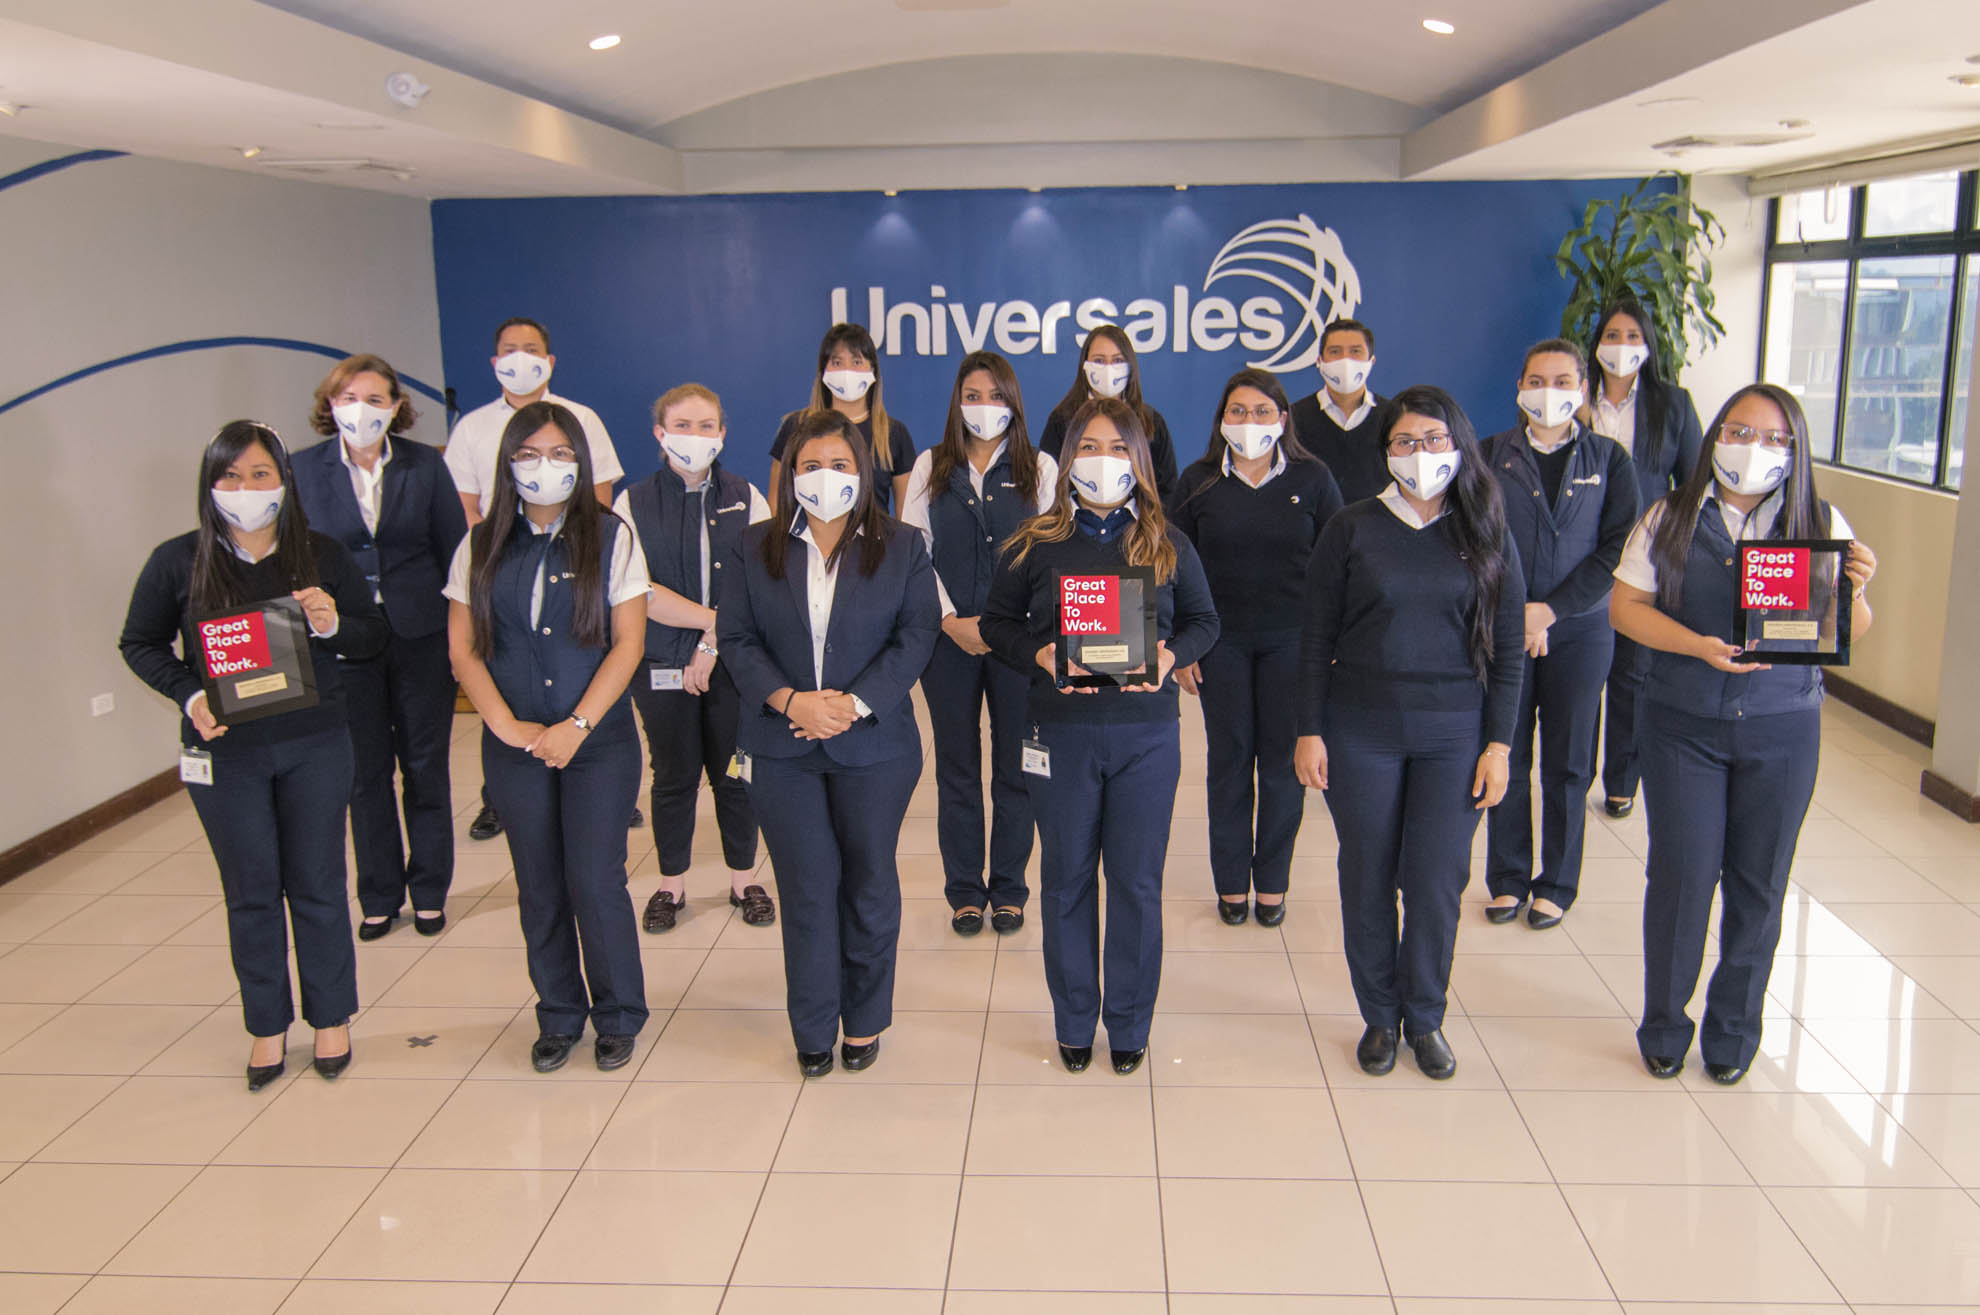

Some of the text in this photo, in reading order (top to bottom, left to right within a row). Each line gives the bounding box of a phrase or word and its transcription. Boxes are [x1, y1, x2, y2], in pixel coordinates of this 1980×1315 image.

[831, 284, 1285, 355] Universales
[1746, 550, 1795, 564] Great
[1747, 564, 1794, 578] Place
[1063, 578, 1106, 591] Great
[1746, 578, 1765, 592] To
[1065, 591, 1106, 605] Place
[1064, 605, 1081, 618] To
[202, 618, 250, 637] Great
[206, 633, 252, 650] Place
[208, 649, 227, 662] To
